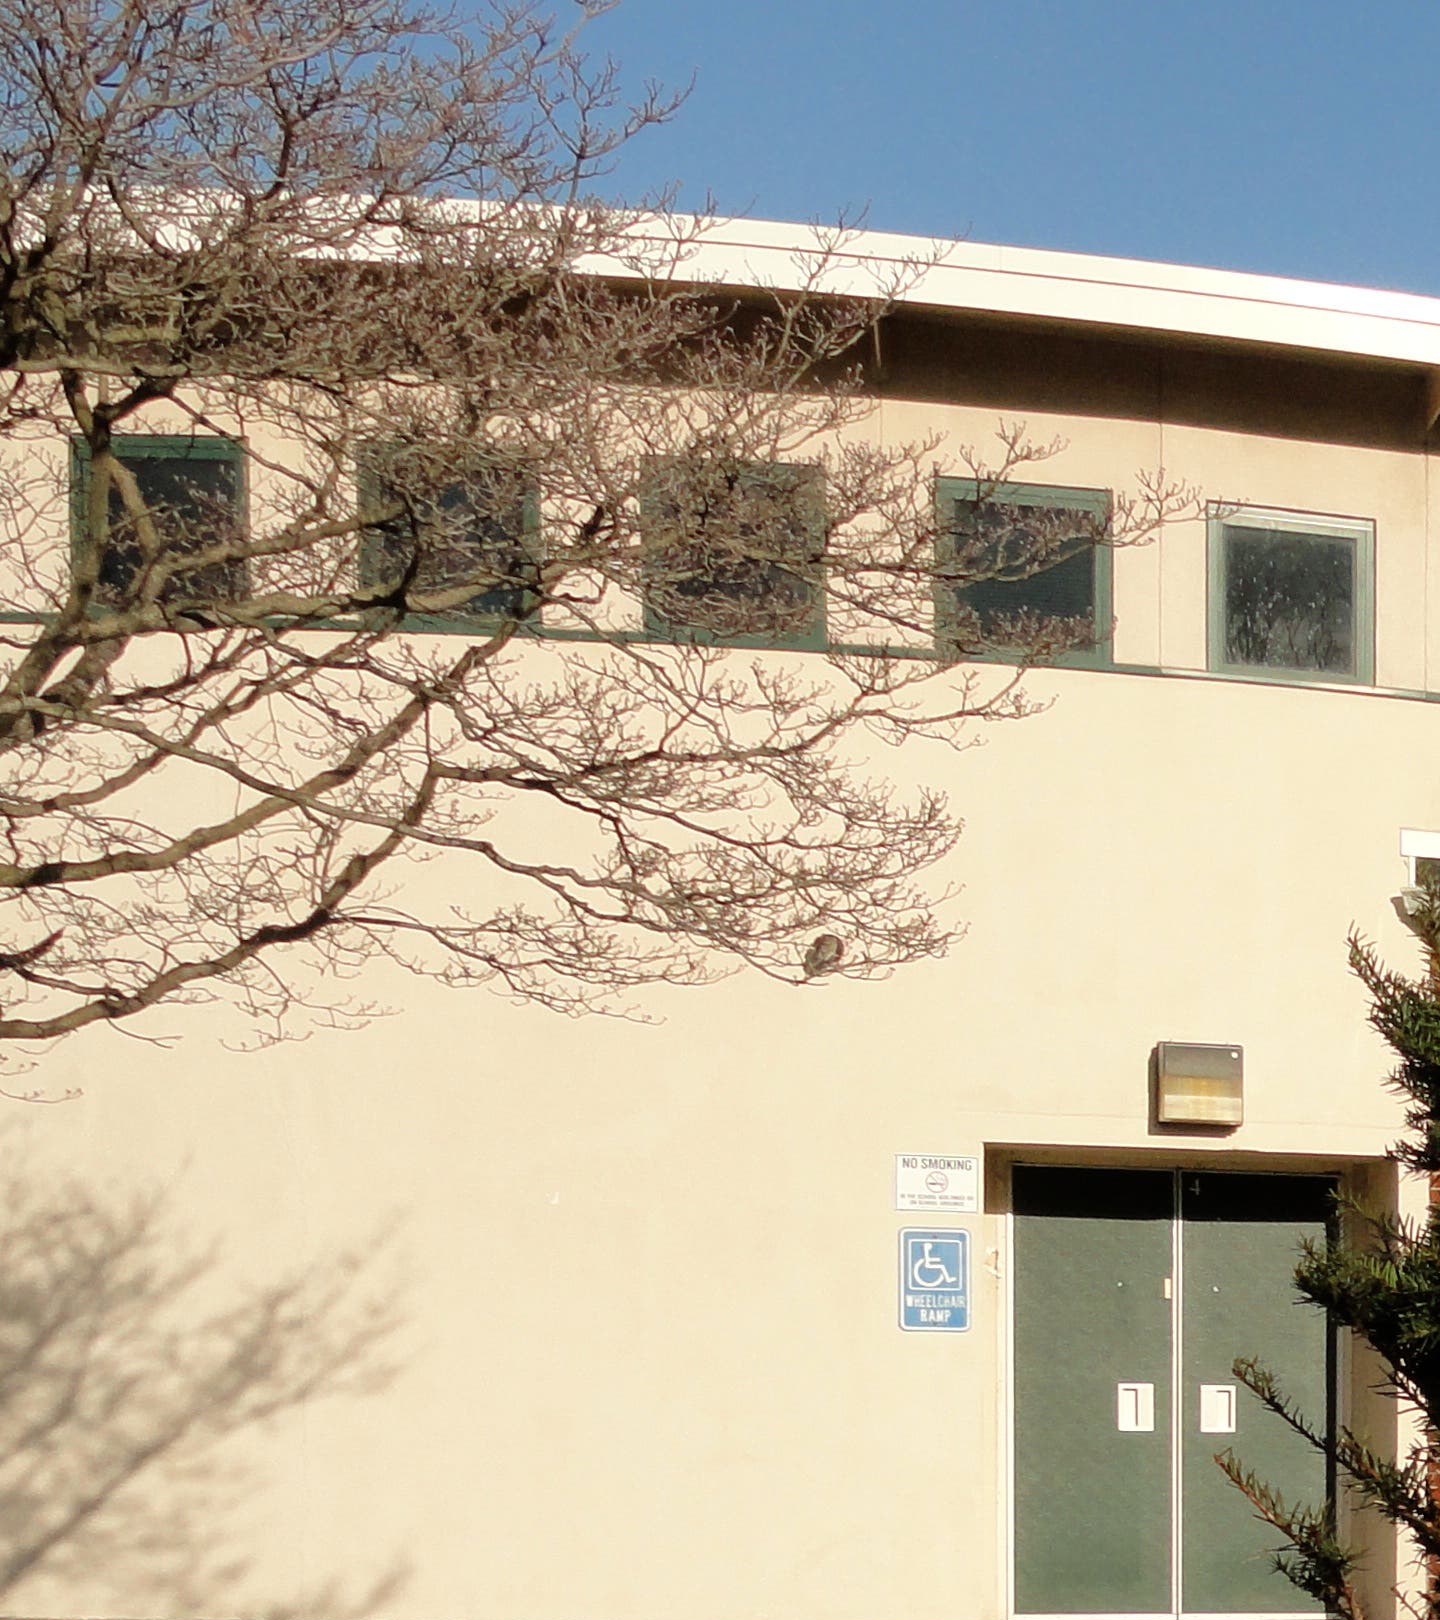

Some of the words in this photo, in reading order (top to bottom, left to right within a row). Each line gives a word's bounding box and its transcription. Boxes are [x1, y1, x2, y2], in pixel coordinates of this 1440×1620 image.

[902, 1157, 918, 1169] NO
[921, 1158, 973, 1171] SMOKING
[905, 1294, 966, 1308] WHEELCHAIR
[920, 1308, 951, 1322] RAMP
